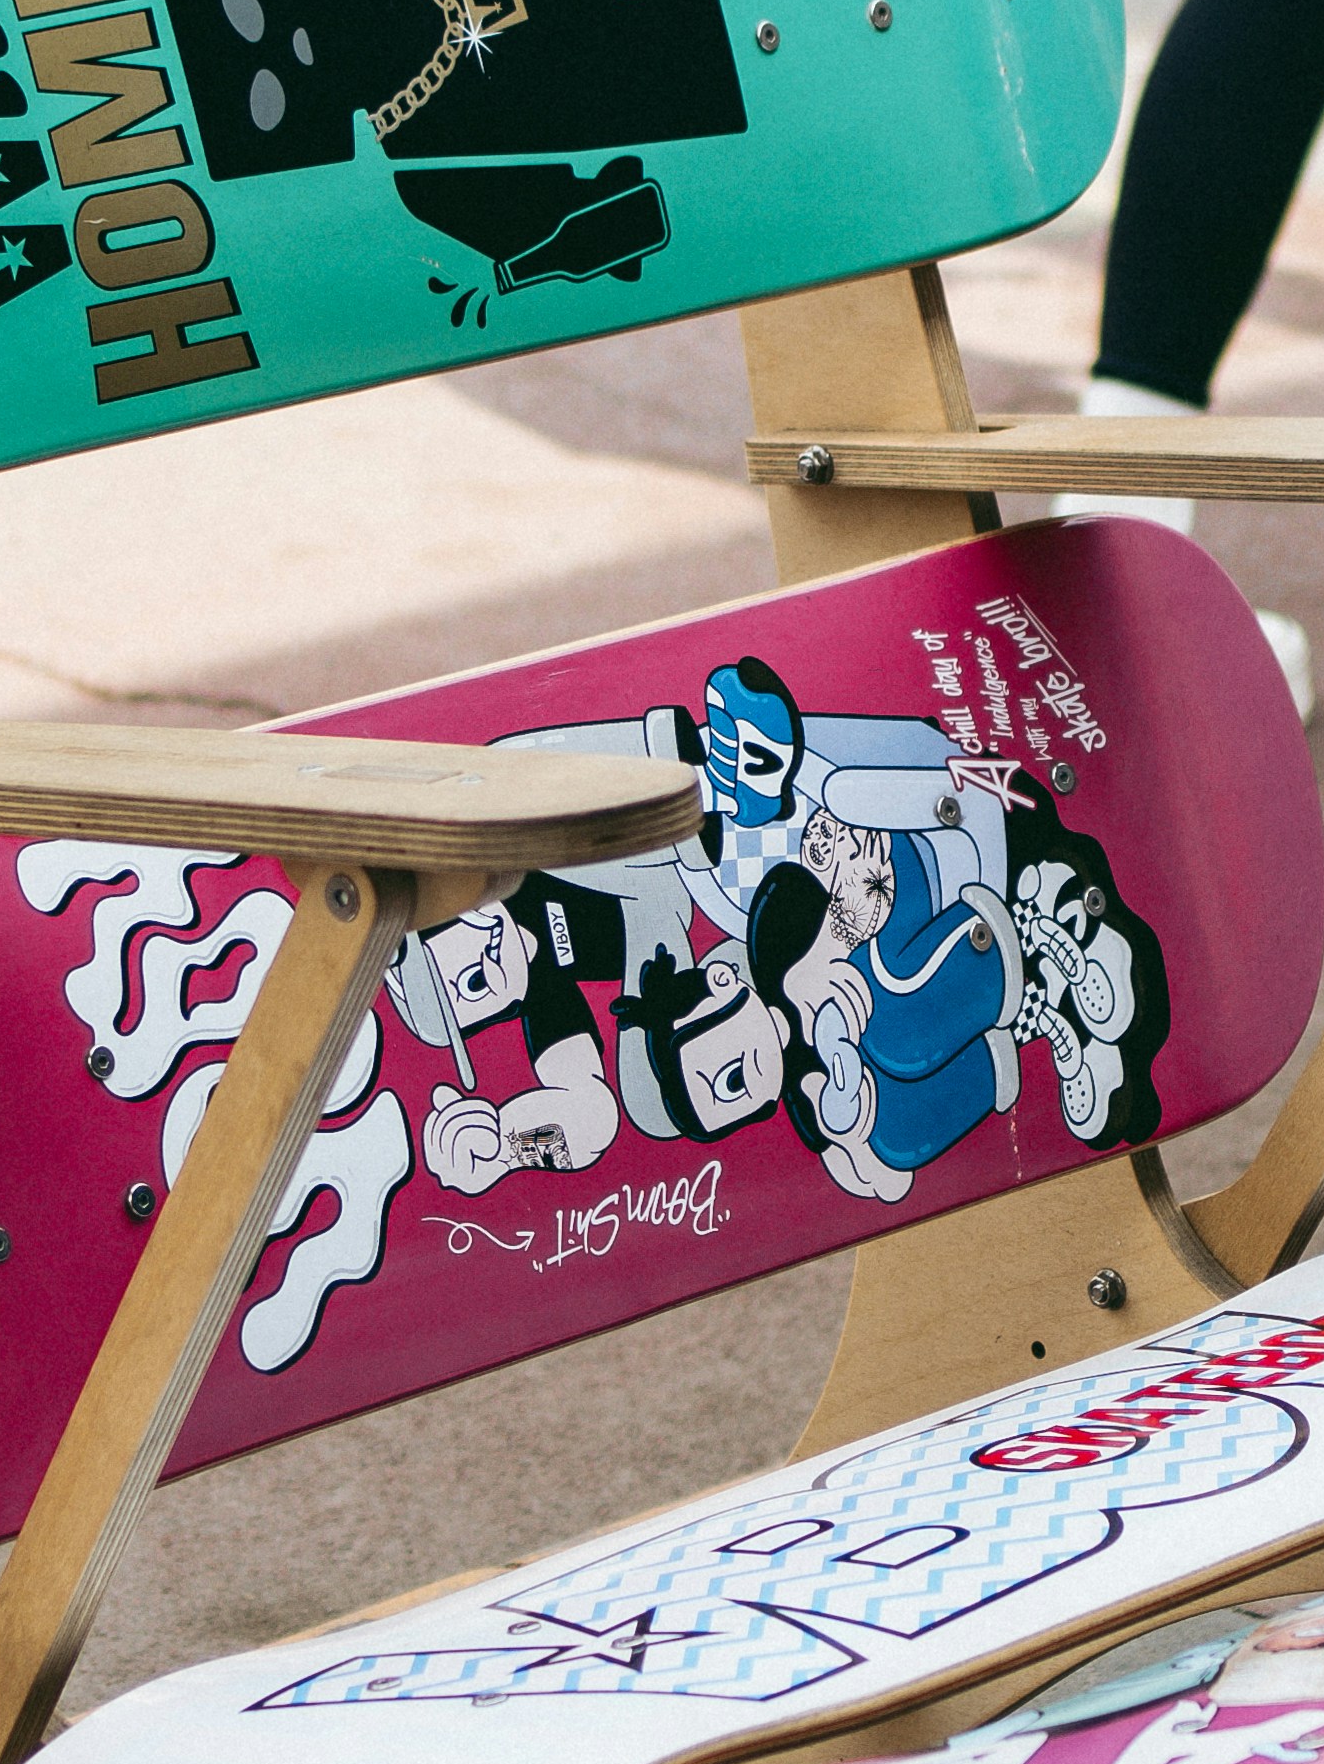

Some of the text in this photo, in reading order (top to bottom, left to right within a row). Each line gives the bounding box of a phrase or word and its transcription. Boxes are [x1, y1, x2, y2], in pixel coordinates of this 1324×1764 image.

[911, 629, 1037, 812] A chill day of
[1020, 698, 1038, 721] my
[550, 912, 570, 957] VBOY
